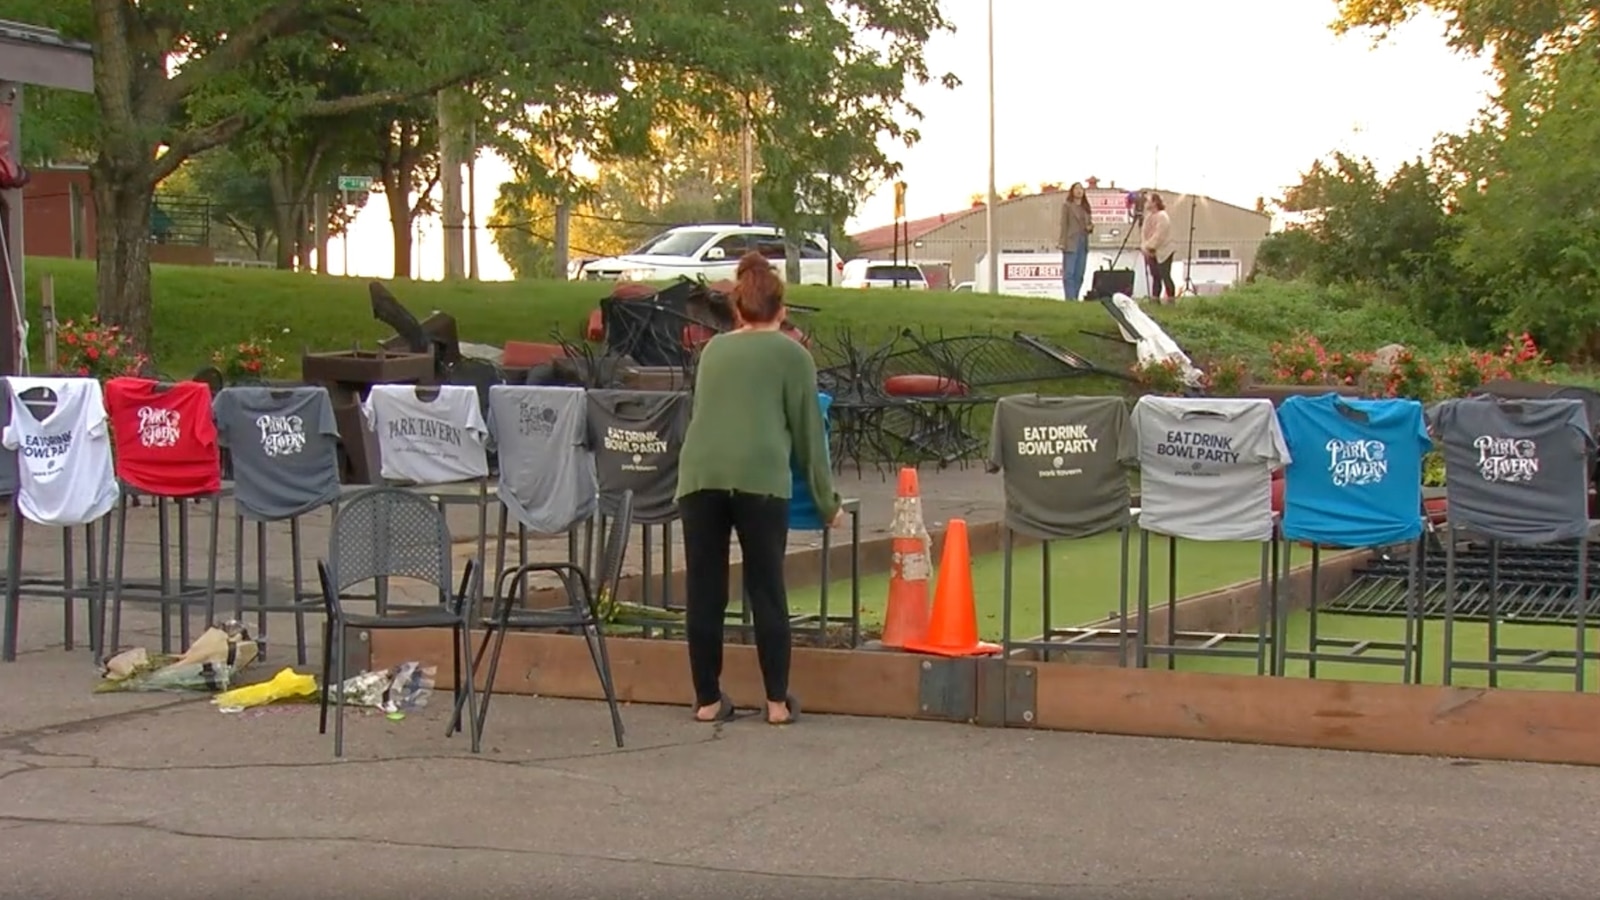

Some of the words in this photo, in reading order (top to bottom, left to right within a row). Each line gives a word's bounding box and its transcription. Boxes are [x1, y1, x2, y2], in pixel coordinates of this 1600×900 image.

[1008, 265, 1035, 277] REDDY
[256, 414, 293, 444] PARK
[389, 417, 416, 439] PARK
[418, 418, 462, 447] TAVERN
[607, 426, 624, 441] EAT
[624, 430, 660, 442] DRINK
[1023, 426, 1047, 441] EAT
[1048, 424, 1088, 440] DRINK
[604, 436, 632, 453] BOWL
[631, 441, 668, 453] PARTY
[1017, 441, 1055, 455] BOWL
[1055, 438, 1098, 454] PARTY
[1167, 430, 1192, 445] EAT
[1192, 432, 1232, 450] DRINK
[1473, 435, 1521, 466] PARK
[1157, 443, 1195, 460] BOWL
[1196, 448, 1240, 464] PARTY
[1325, 438, 1372, 471] PARK
[1332, 457, 1388, 487] TAVERN
[1481, 455, 1539, 482] TAVERN
